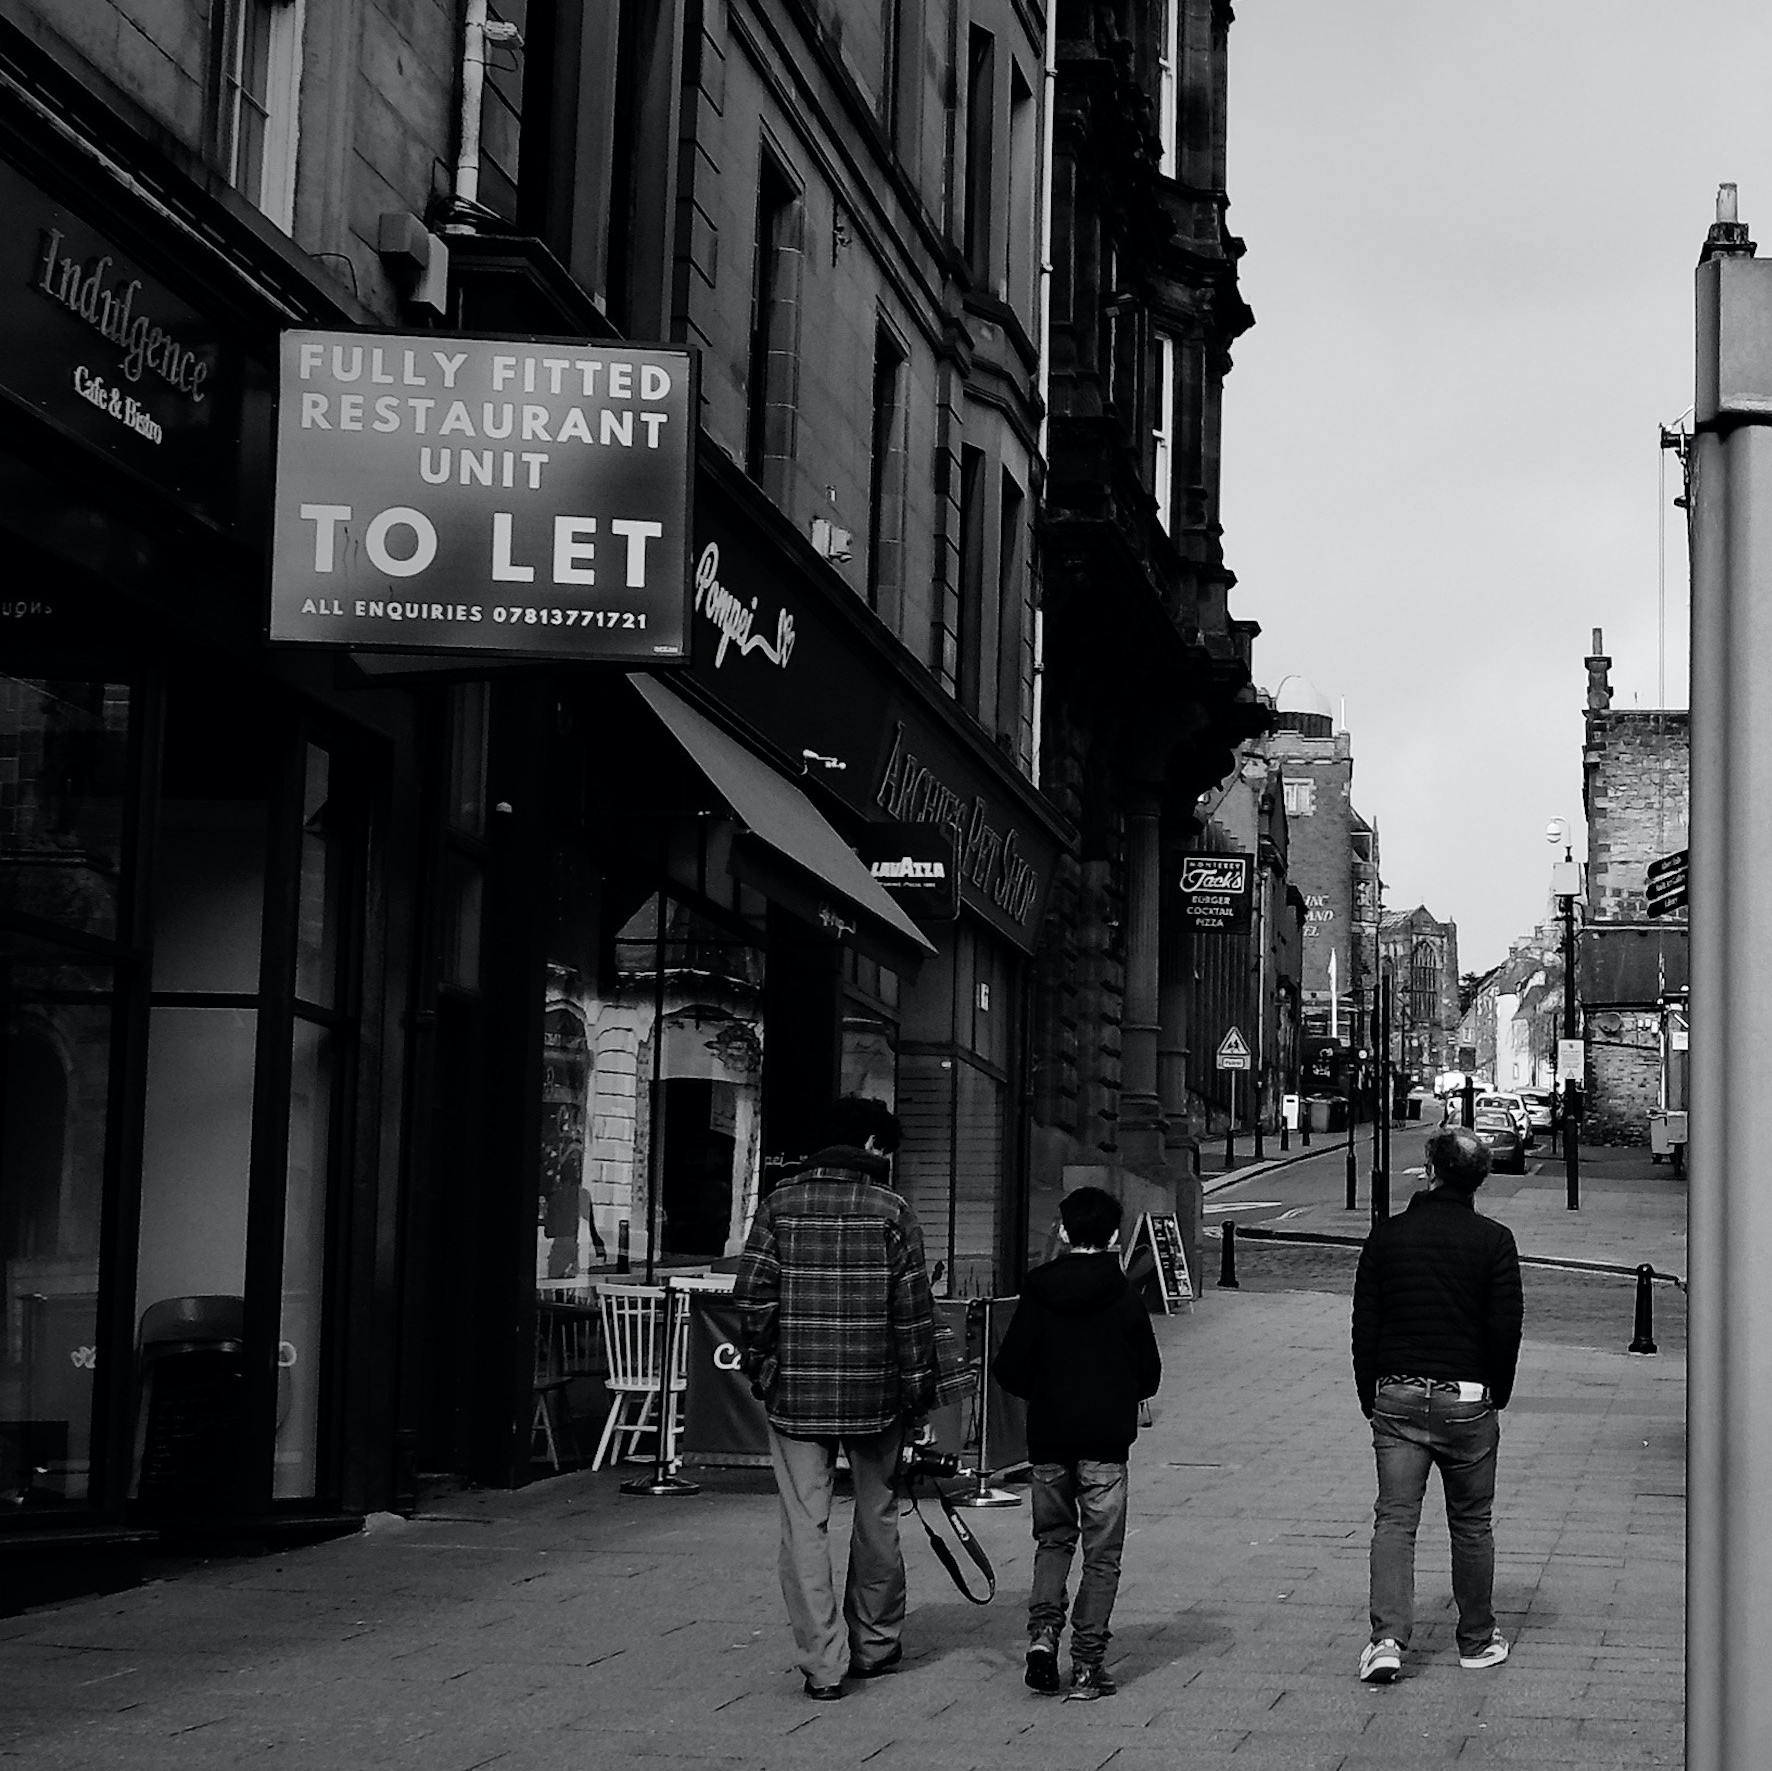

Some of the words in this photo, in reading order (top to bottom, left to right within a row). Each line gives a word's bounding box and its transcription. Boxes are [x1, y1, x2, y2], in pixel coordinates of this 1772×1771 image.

[39, 228, 208, 403] Indulgence
[300, 342, 468, 388] FULLY
[492, 356, 671, 400] FITTED
[107, 388, 123, 418] &
[124, 395, 162, 445] Bistro
[301, 392, 668, 448] RESTAURANT
[420, 447, 549, 489] UNIT
[300, 503, 437, 577] TO
[492, 512, 663, 588] LET
[301, 599, 344, 616] ALL
[355, 601, 483, 622] ENQUIRIES
[493, 607, 647, 629] 07813771721
[694, 541, 764, 669] Pompei
[870, 856, 945, 878] LAVAZZA
[962, 795, 1003, 893] PET
[994, 828, 1038, 926] SHOP
[1180, 869, 1242, 893] Jack's
[1186, 906, 1234, 916] COCKTAIL
[1191, 896, 1231, 905] BURGER
[1195, 918, 1225, 928] PIZZA
